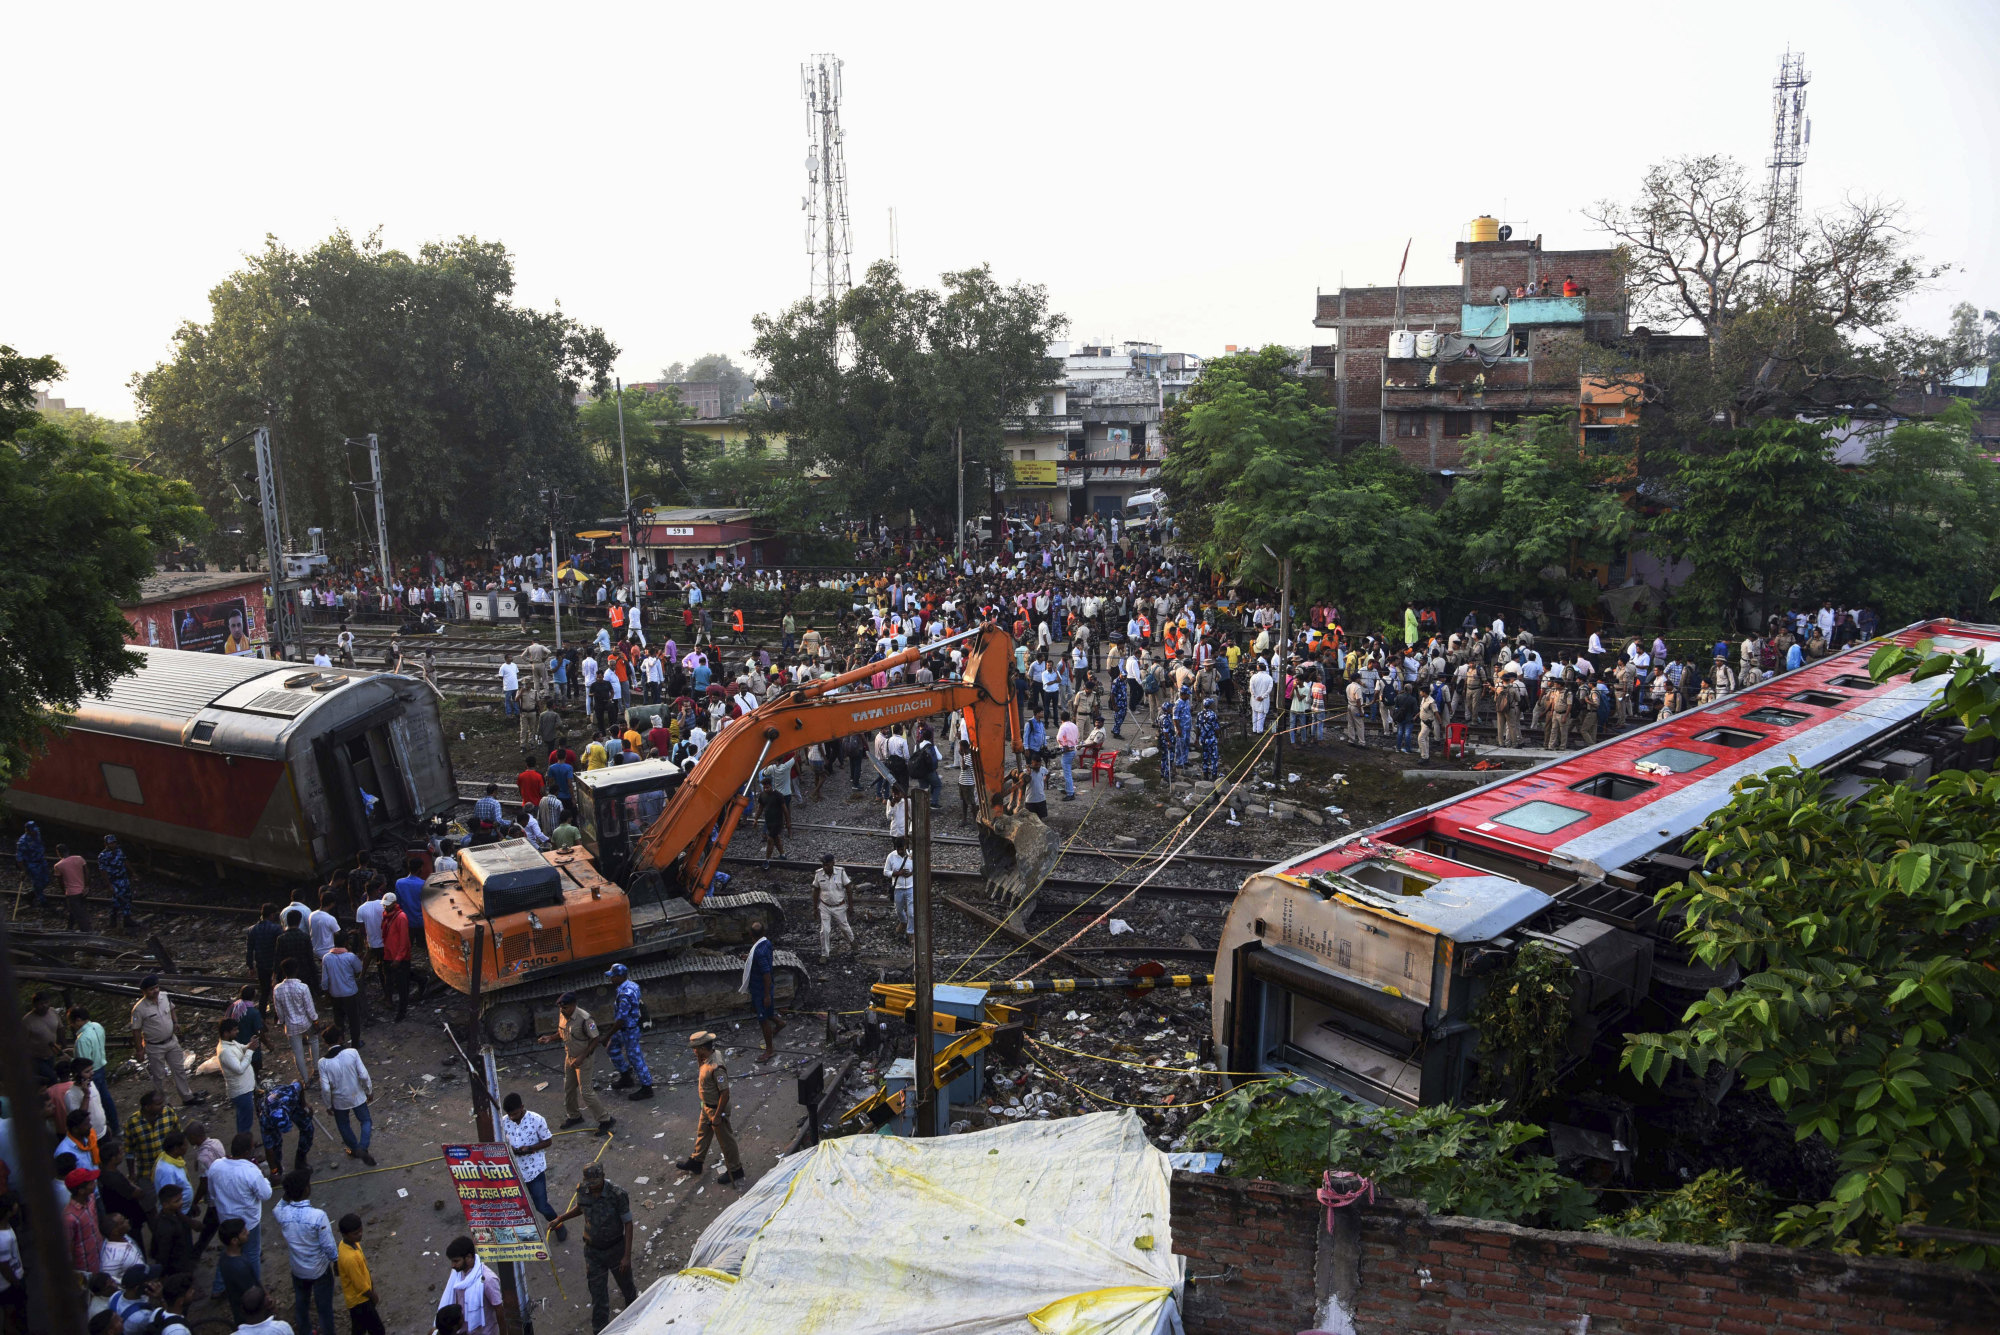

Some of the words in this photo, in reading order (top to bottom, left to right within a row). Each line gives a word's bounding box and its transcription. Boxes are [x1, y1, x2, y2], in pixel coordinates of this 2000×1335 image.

[851, 708, 884, 722] TATA
[885, 698, 932, 716] HITACHI
[449, 1160, 481, 1180] शांति
[478, 1160, 514, 1180] पैलेस
[457, 1183, 479, 1199] मैरेज
[477, 1187, 501, 1199] उत्सव
[499, 1186, 522, 1198] भवन
